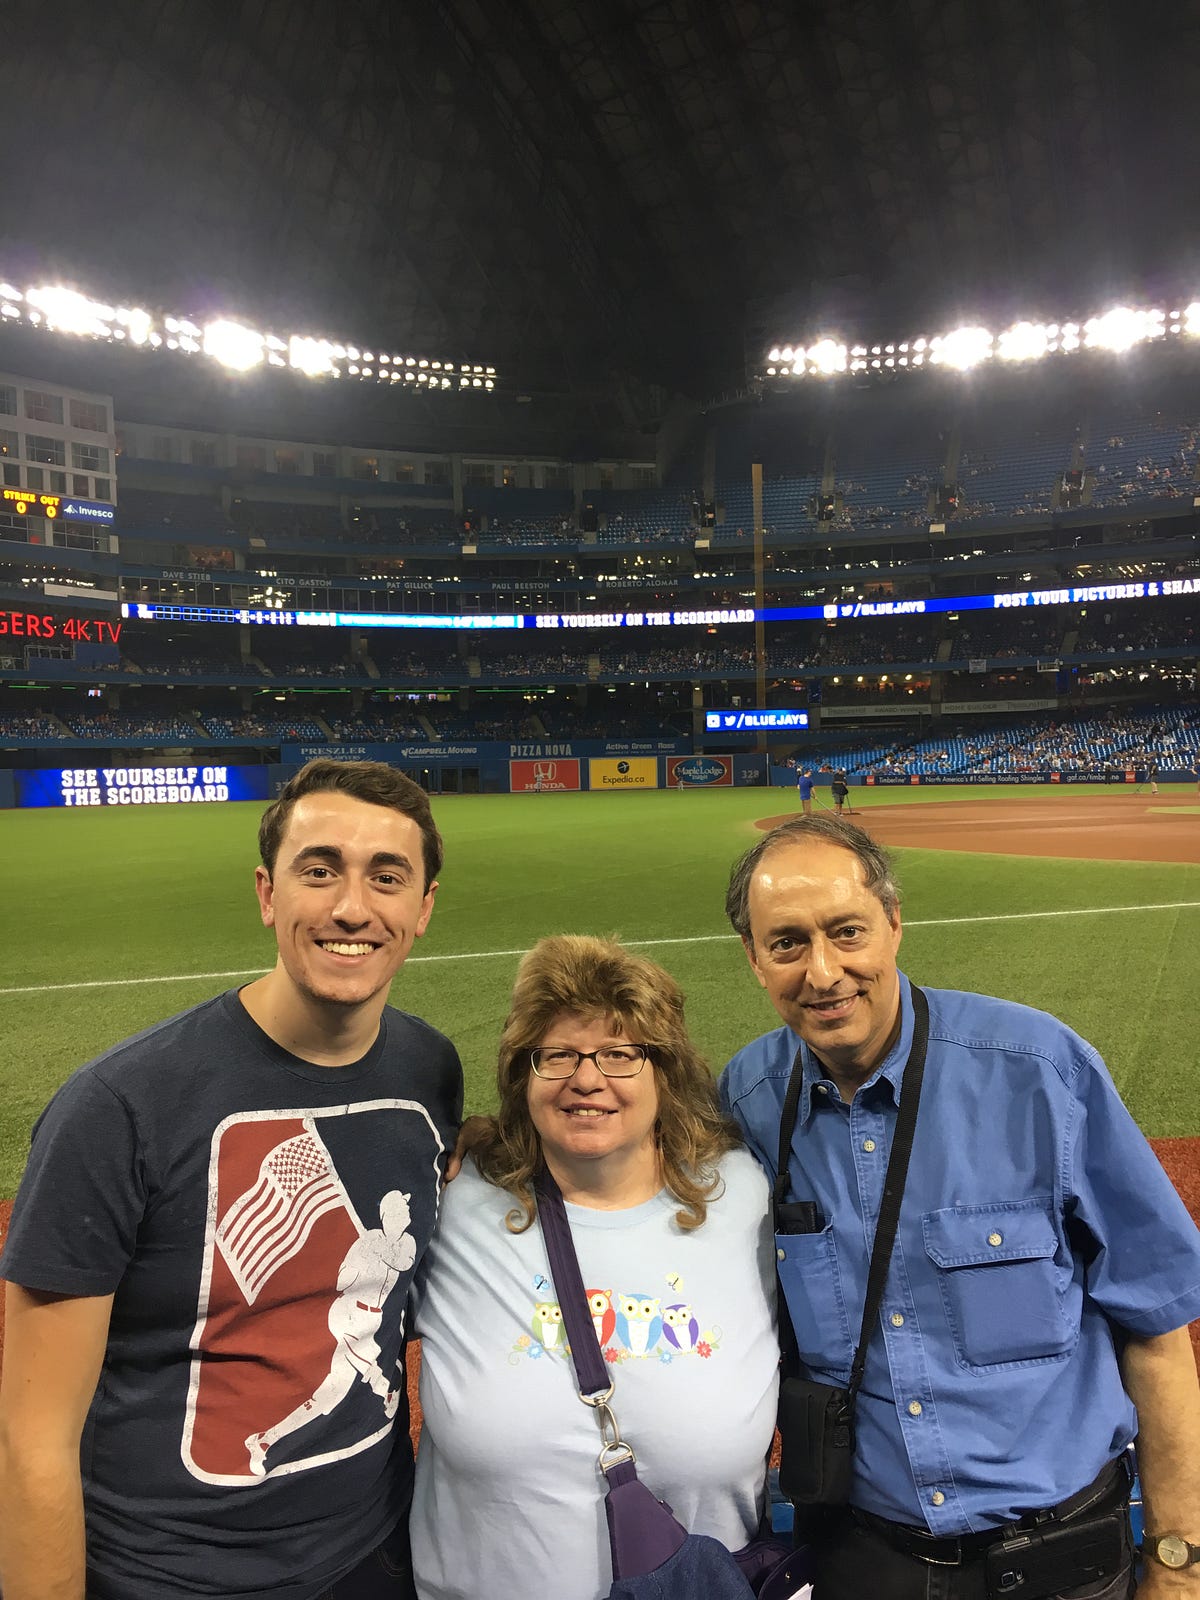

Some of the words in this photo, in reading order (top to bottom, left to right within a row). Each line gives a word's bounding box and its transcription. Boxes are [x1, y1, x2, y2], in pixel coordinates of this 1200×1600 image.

[3, 490, 36, 503] STRIKE
[40, 496, 60, 506] OUT
[16, 501, 27, 514] 0
[46, 505, 57, 518] 0
[79, 506, 114, 518] Invesco
[162, 571, 184, 579] DAVE
[276, 578, 295, 586] CITO
[298, 578, 332, 587] GASTON
[386, 581, 401, 589] PAT
[606, 580, 642, 588] ROBERTO
[993, 593, 1029, 609] POST
[1031, 590, 1069, 605] YOUR
[1073, 583, 1144, 602] PICTURES
[1148, 583, 1158, 596] &
[536, 614, 559, 628] SEE
[561, 613, 623, 627] YOURSELF
[626, 613, 643, 626] ON
[646, 612, 671, 626] THE
[674, 609, 755, 624] SCOREBOARD
[93, 621, 122, 643] TV
[300, 747, 367, 755] PRESZLER
[510, 744, 542, 757] PIZZA
[545, 744, 573, 756] NOVA
[61, 769, 98, 788] SEE
[102, 768, 198, 786] YOURSELF
[202, 766, 227, 784] ON
[602, 775, 646, 785] Expedia.ca
[61, 787, 101, 806] THE
[107, 785, 229, 804] SCOREBOARD
